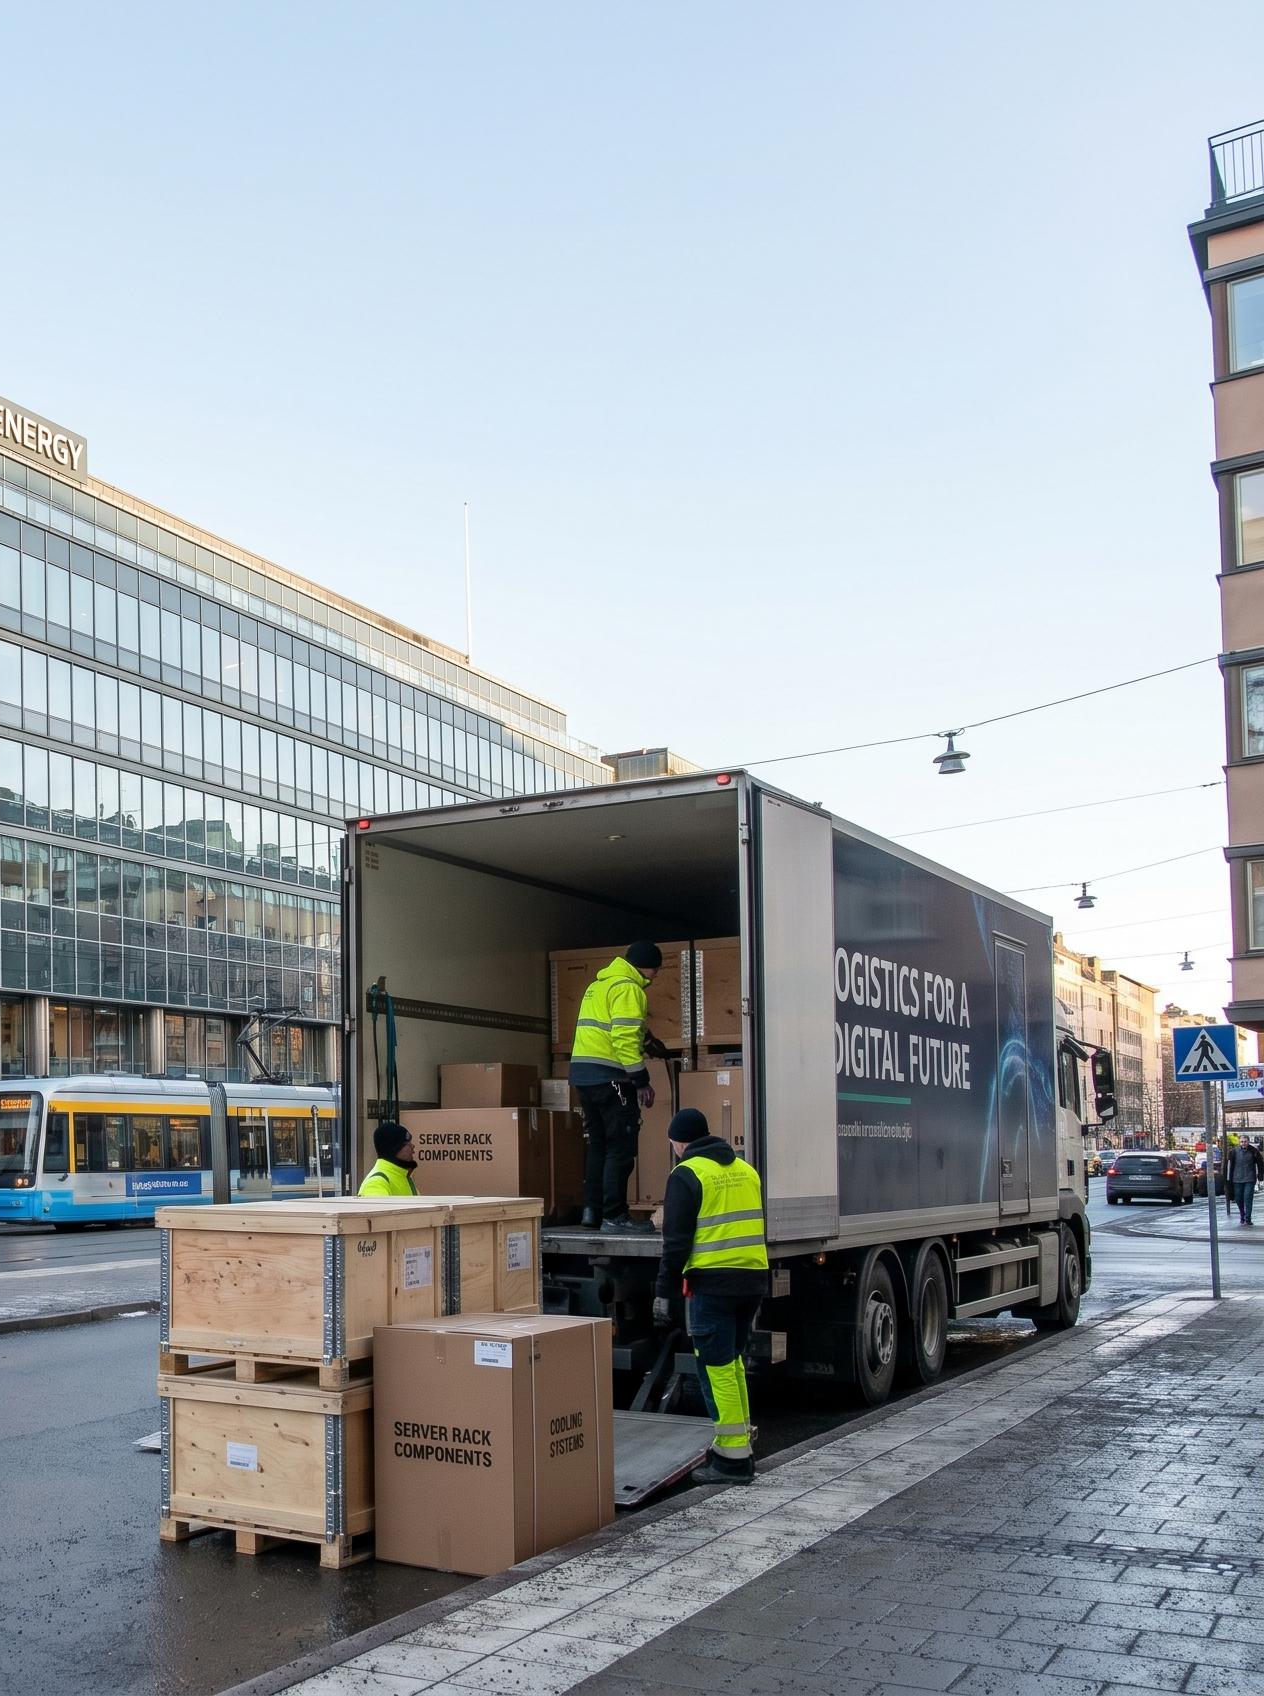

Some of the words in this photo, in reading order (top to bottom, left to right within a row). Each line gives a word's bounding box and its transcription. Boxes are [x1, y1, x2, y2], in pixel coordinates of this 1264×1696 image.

[835, 947, 920, 1018] OGISTICS
[924, 971, 956, 1026] FOR
[959, 982, 971, 1029] A
[909, 1034, 971, 1090] FUTURE
[419, 1133, 461, 1145] SERVER
[463, 1133, 493, 1145] RACK
[418, 1149, 494, 1161] COMPONENTS
[394, 1421, 448, 1442] SERVER
[452, 1427, 492, 1447] RACK
[550, 1411, 583, 1436] COOLING
[394, 1442, 493, 1468] COMPONENTS
